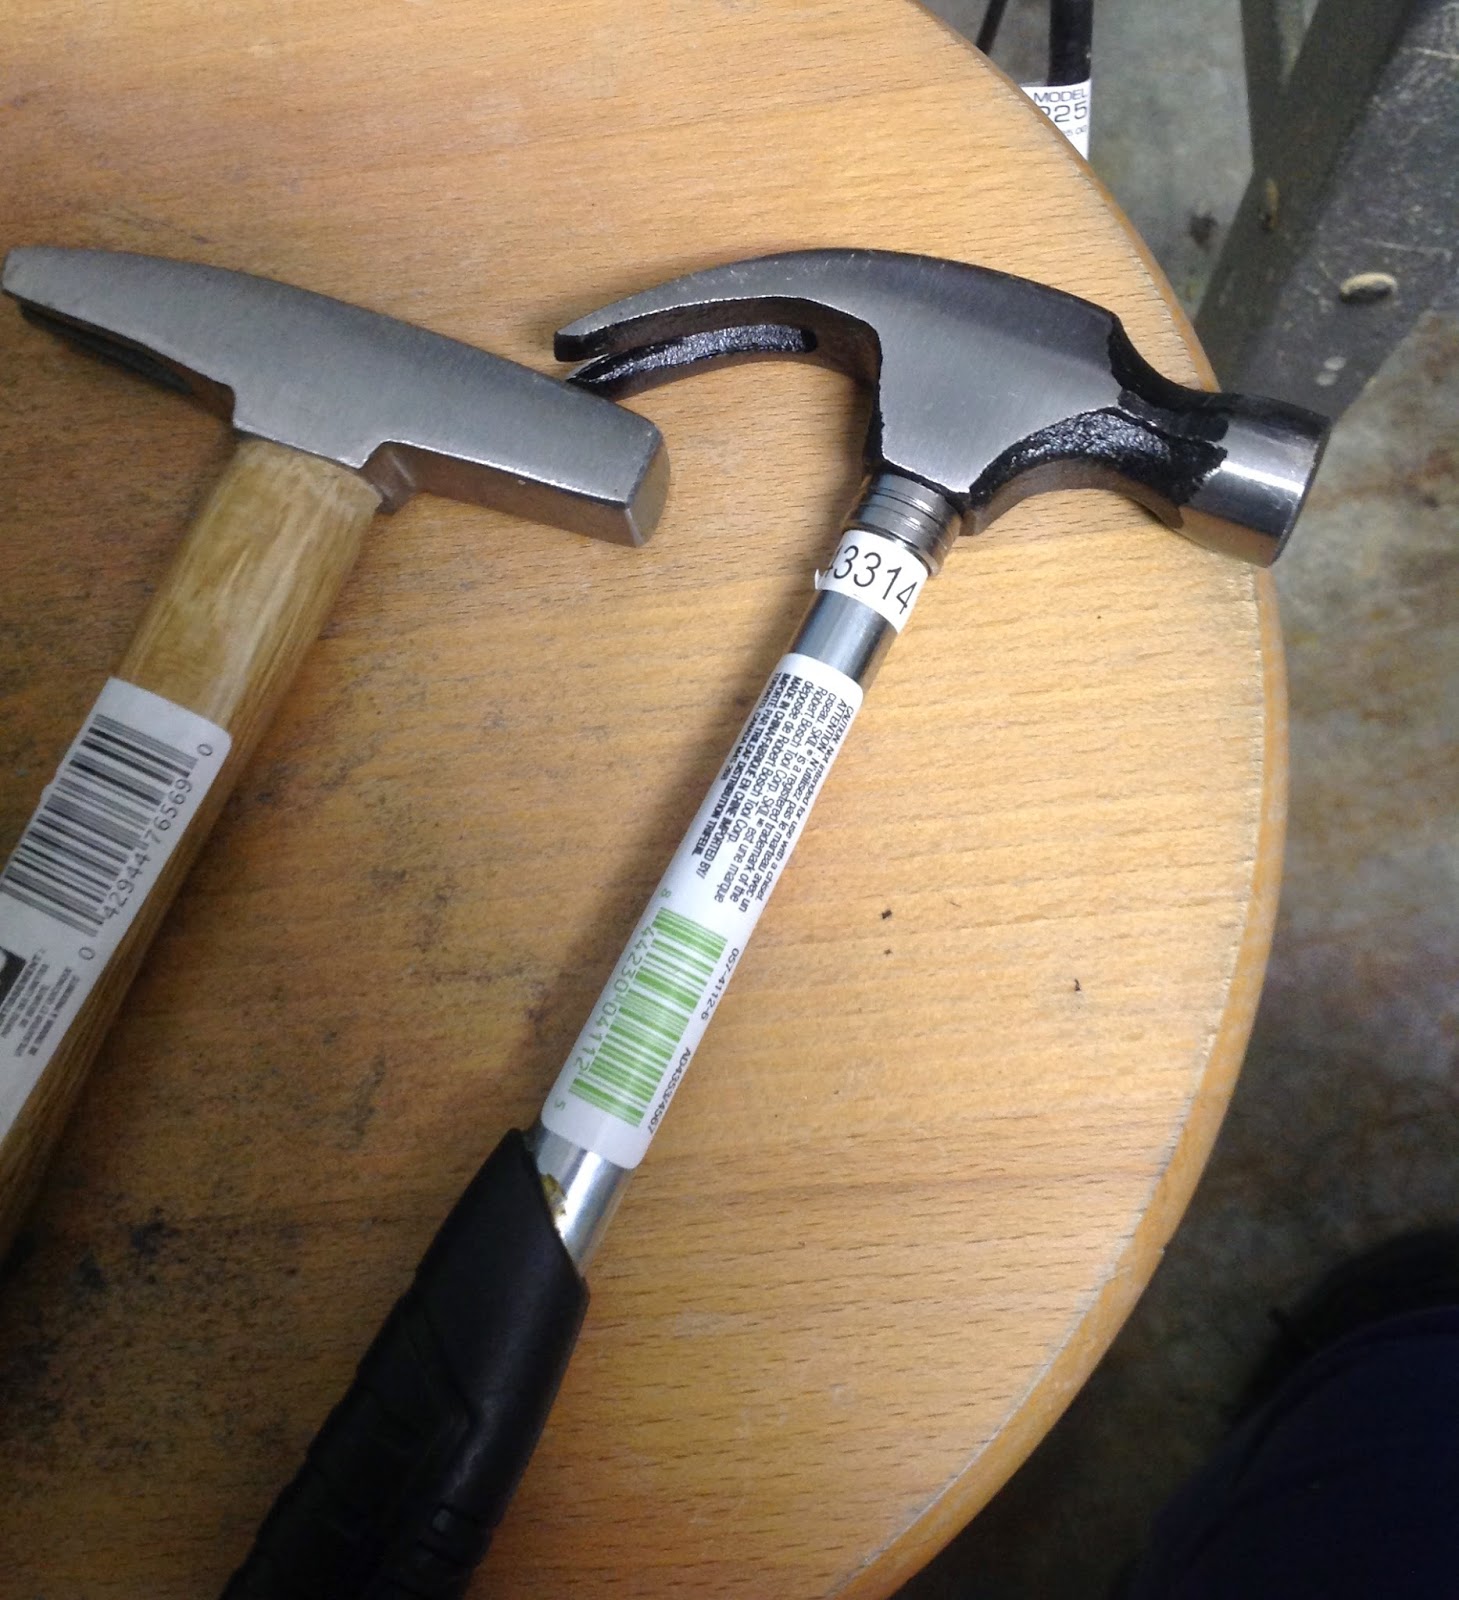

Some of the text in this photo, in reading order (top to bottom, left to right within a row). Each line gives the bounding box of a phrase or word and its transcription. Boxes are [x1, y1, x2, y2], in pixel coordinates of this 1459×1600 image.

[1033, 88, 1087, 102] MODEL
[825, 545, 918, 615] 3314
[767, 671, 791, 710] IMPORTÉ
[783, 675, 802, 701] MADE
[778, 699, 790, 711] IN
[804, 685, 828, 719] Robert
[758, 707, 772, 727] PAR
[789, 717, 812, 749] Bosch
[726, 679, 816, 844] déposée de Robert Bosch Tool Corp.
[780, 747, 798, 770] Tool
[795, 754, 808, 765] is
[821, 745, 834, 763] Not
[766, 768, 787, 794] Corp.
[792, 764, 802, 773] a
[792, 757, 820, 800] N'utilisez
[710, 760, 746, 820] DISTRIBUTION
[737, 776, 751, 792] EN
[801, 763, 826, 805] intended
[725, 789, 745, 818] CHINE
[767, 772, 798, 823] registered
[782, 799, 797, 820] pas
[794, 805, 806, 820] for
[702, 816, 732, 862] IMPORTED
[743, 826, 756, 844] est
[777, 820, 789, 832] le
[785, 820, 797, 839] use
[78, 743, 214, 961] 0 42944 76569 0
[733, 843, 748, 864] une
[743, 821, 776, 874] trademark
[757, 831, 782, 873] marteau
[775, 839, 789, 861] with
[694, 860, 711, 879] BY/
[770, 861, 778, 869] a
[712, 863, 739, 903] marque
[737, 872, 750, 886] of
[745, 872, 762, 898] avec
[754, 870, 774, 902] chisel.
[728, 884, 745, 903] the
[738, 897, 750, 912] un
[699, 947, 740, 1022] 057-4112-6
[553, 888, 672, 1111] 8 44230 04112 5
[645, 1047, 692, 1135] AD4353/4567
